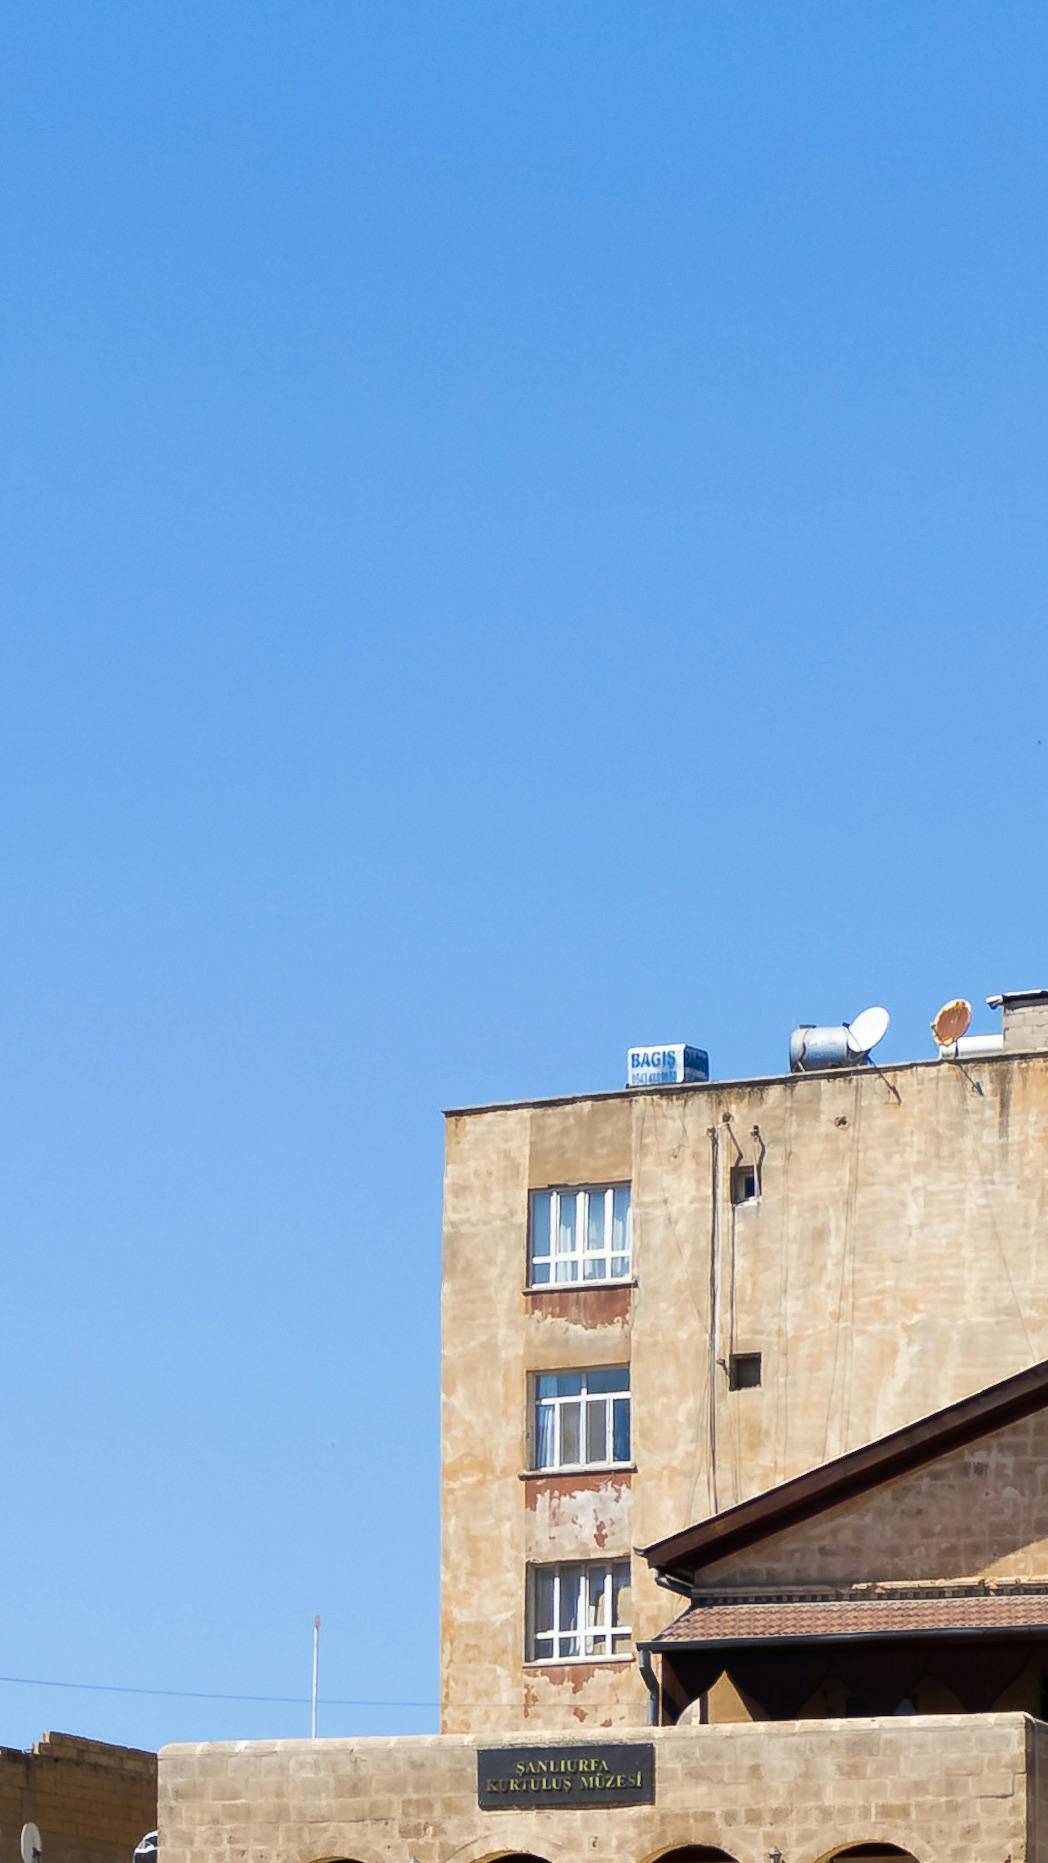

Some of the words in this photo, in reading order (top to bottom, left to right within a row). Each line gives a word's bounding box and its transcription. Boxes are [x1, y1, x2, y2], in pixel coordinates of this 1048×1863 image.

[515, 1759, 609, 1777] ŞANLIURFA
[486, 1777, 572, 1793] KURTULUŞ
[580, 1771, 642, 1789] MÜZESİ
